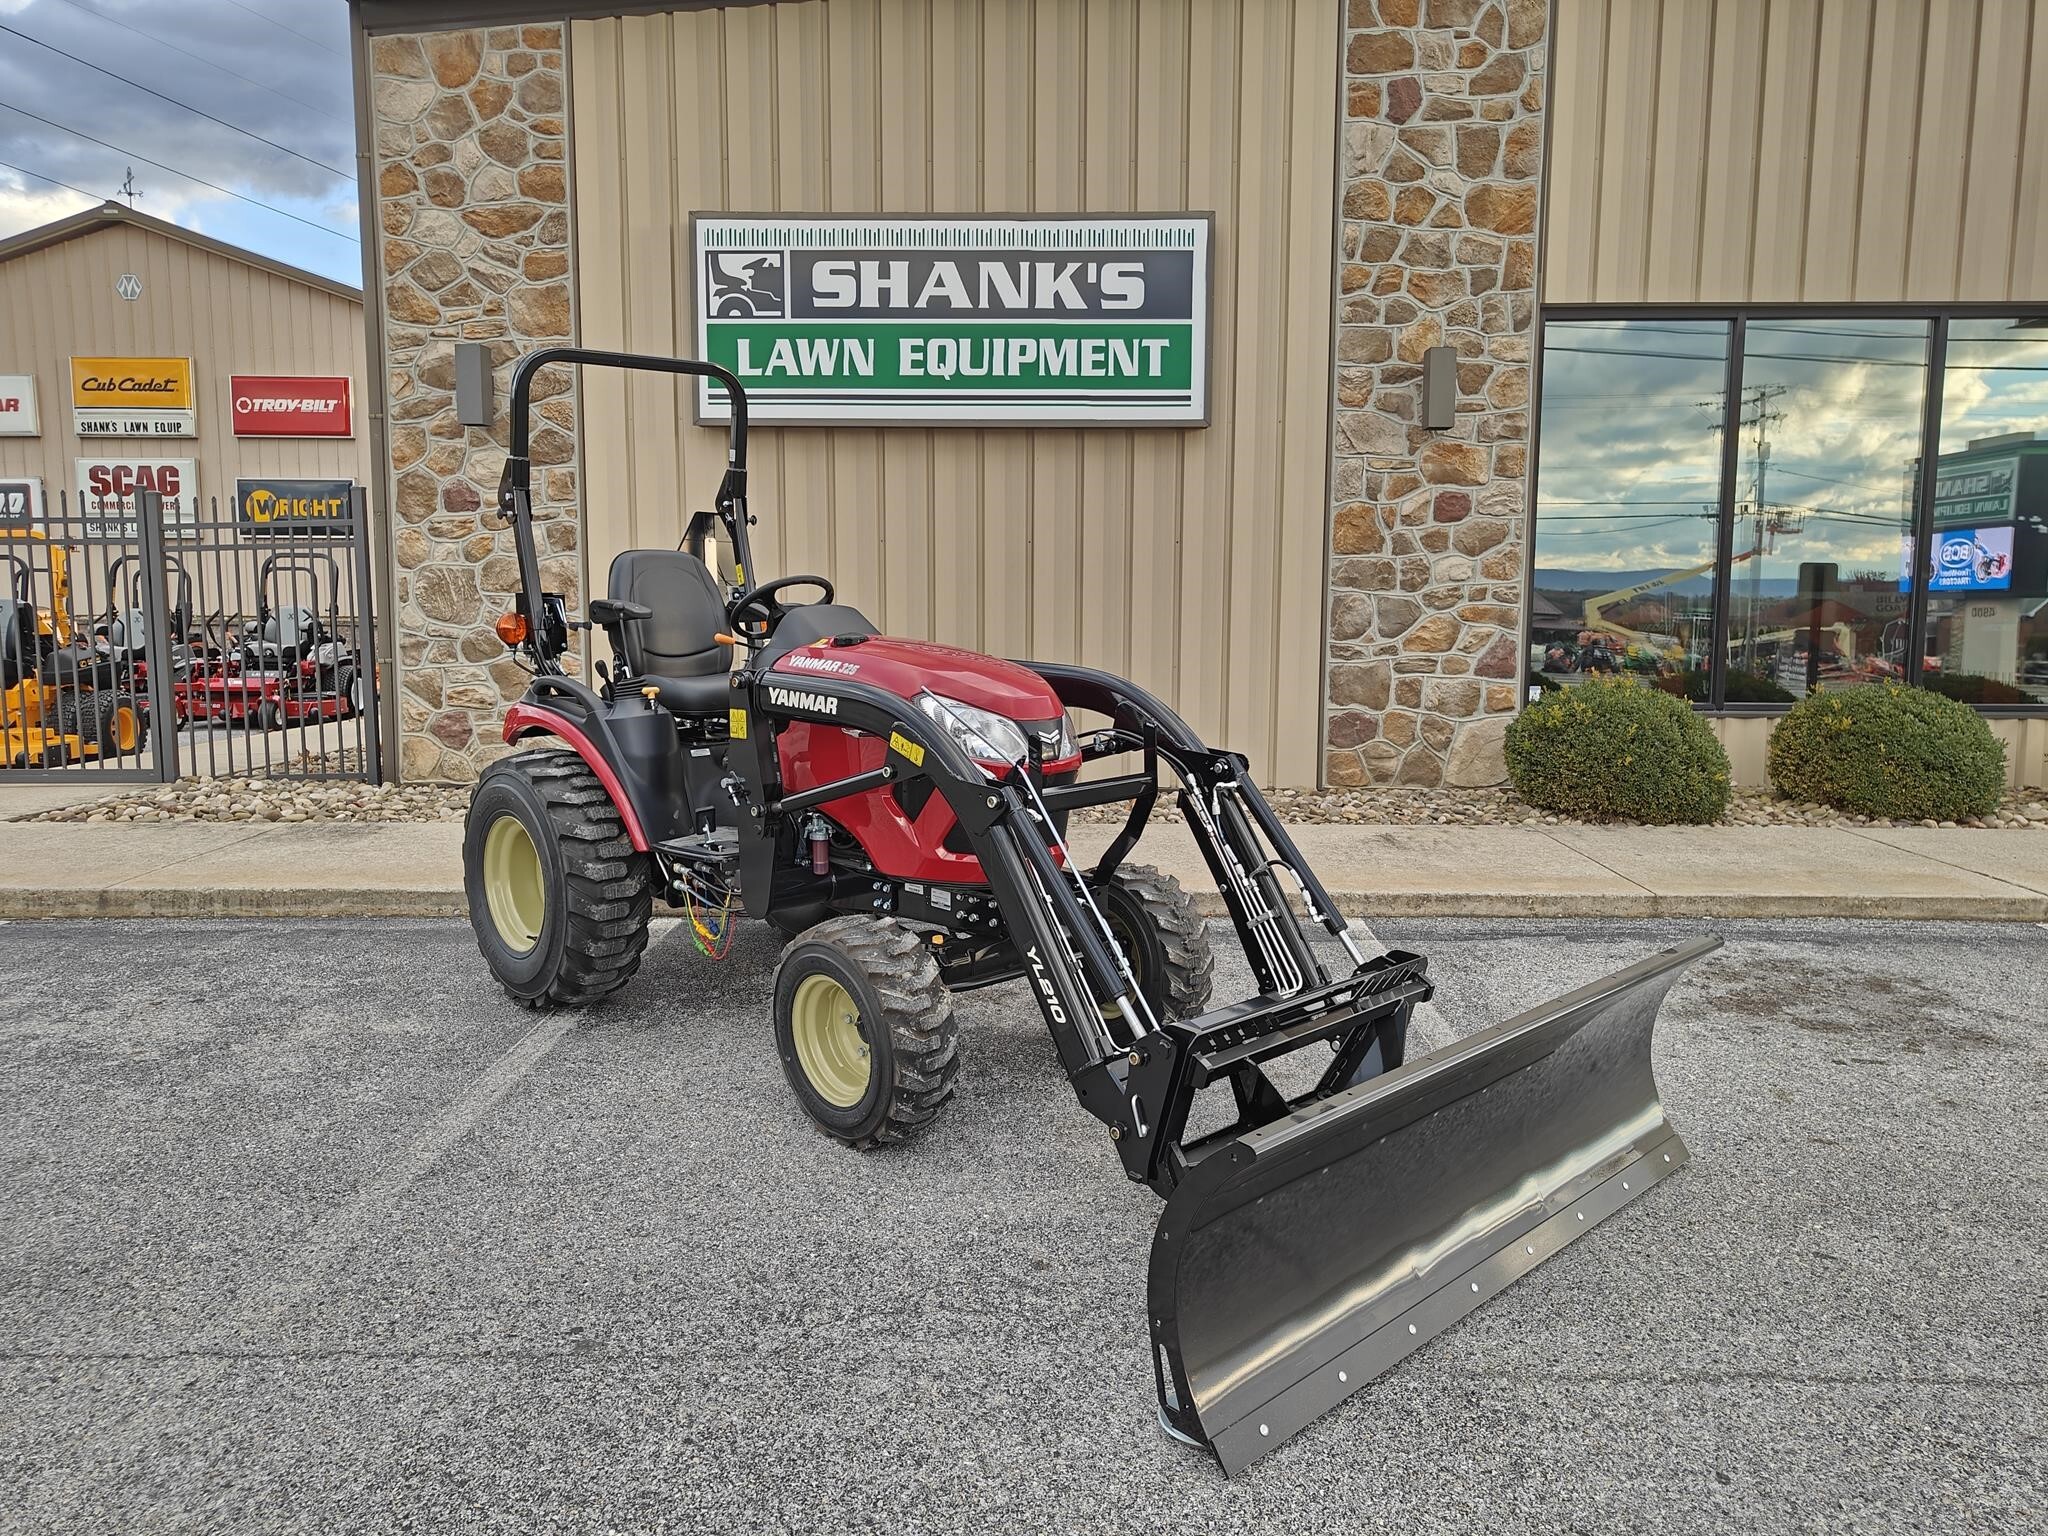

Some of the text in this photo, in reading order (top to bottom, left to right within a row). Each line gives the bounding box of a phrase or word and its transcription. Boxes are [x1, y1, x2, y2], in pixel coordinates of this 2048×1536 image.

[811, 260, 1146, 310] SHANK'S
[737, 338, 1170, 380] LAWN EQUIPMENT
[81, 377, 178, 392] Cub Cadet
[252, 398, 339, 413] TROY-BILT
[81, 420, 118, 433] SHANK'S
[124, 421, 149, 433] LAWN
[89, 465, 181, 497] SCAG
[788, 655, 842, 672] YANMAR
[768, 686, 838, 715] YANMAR
[1026, 945, 1067, 1024] YL210
